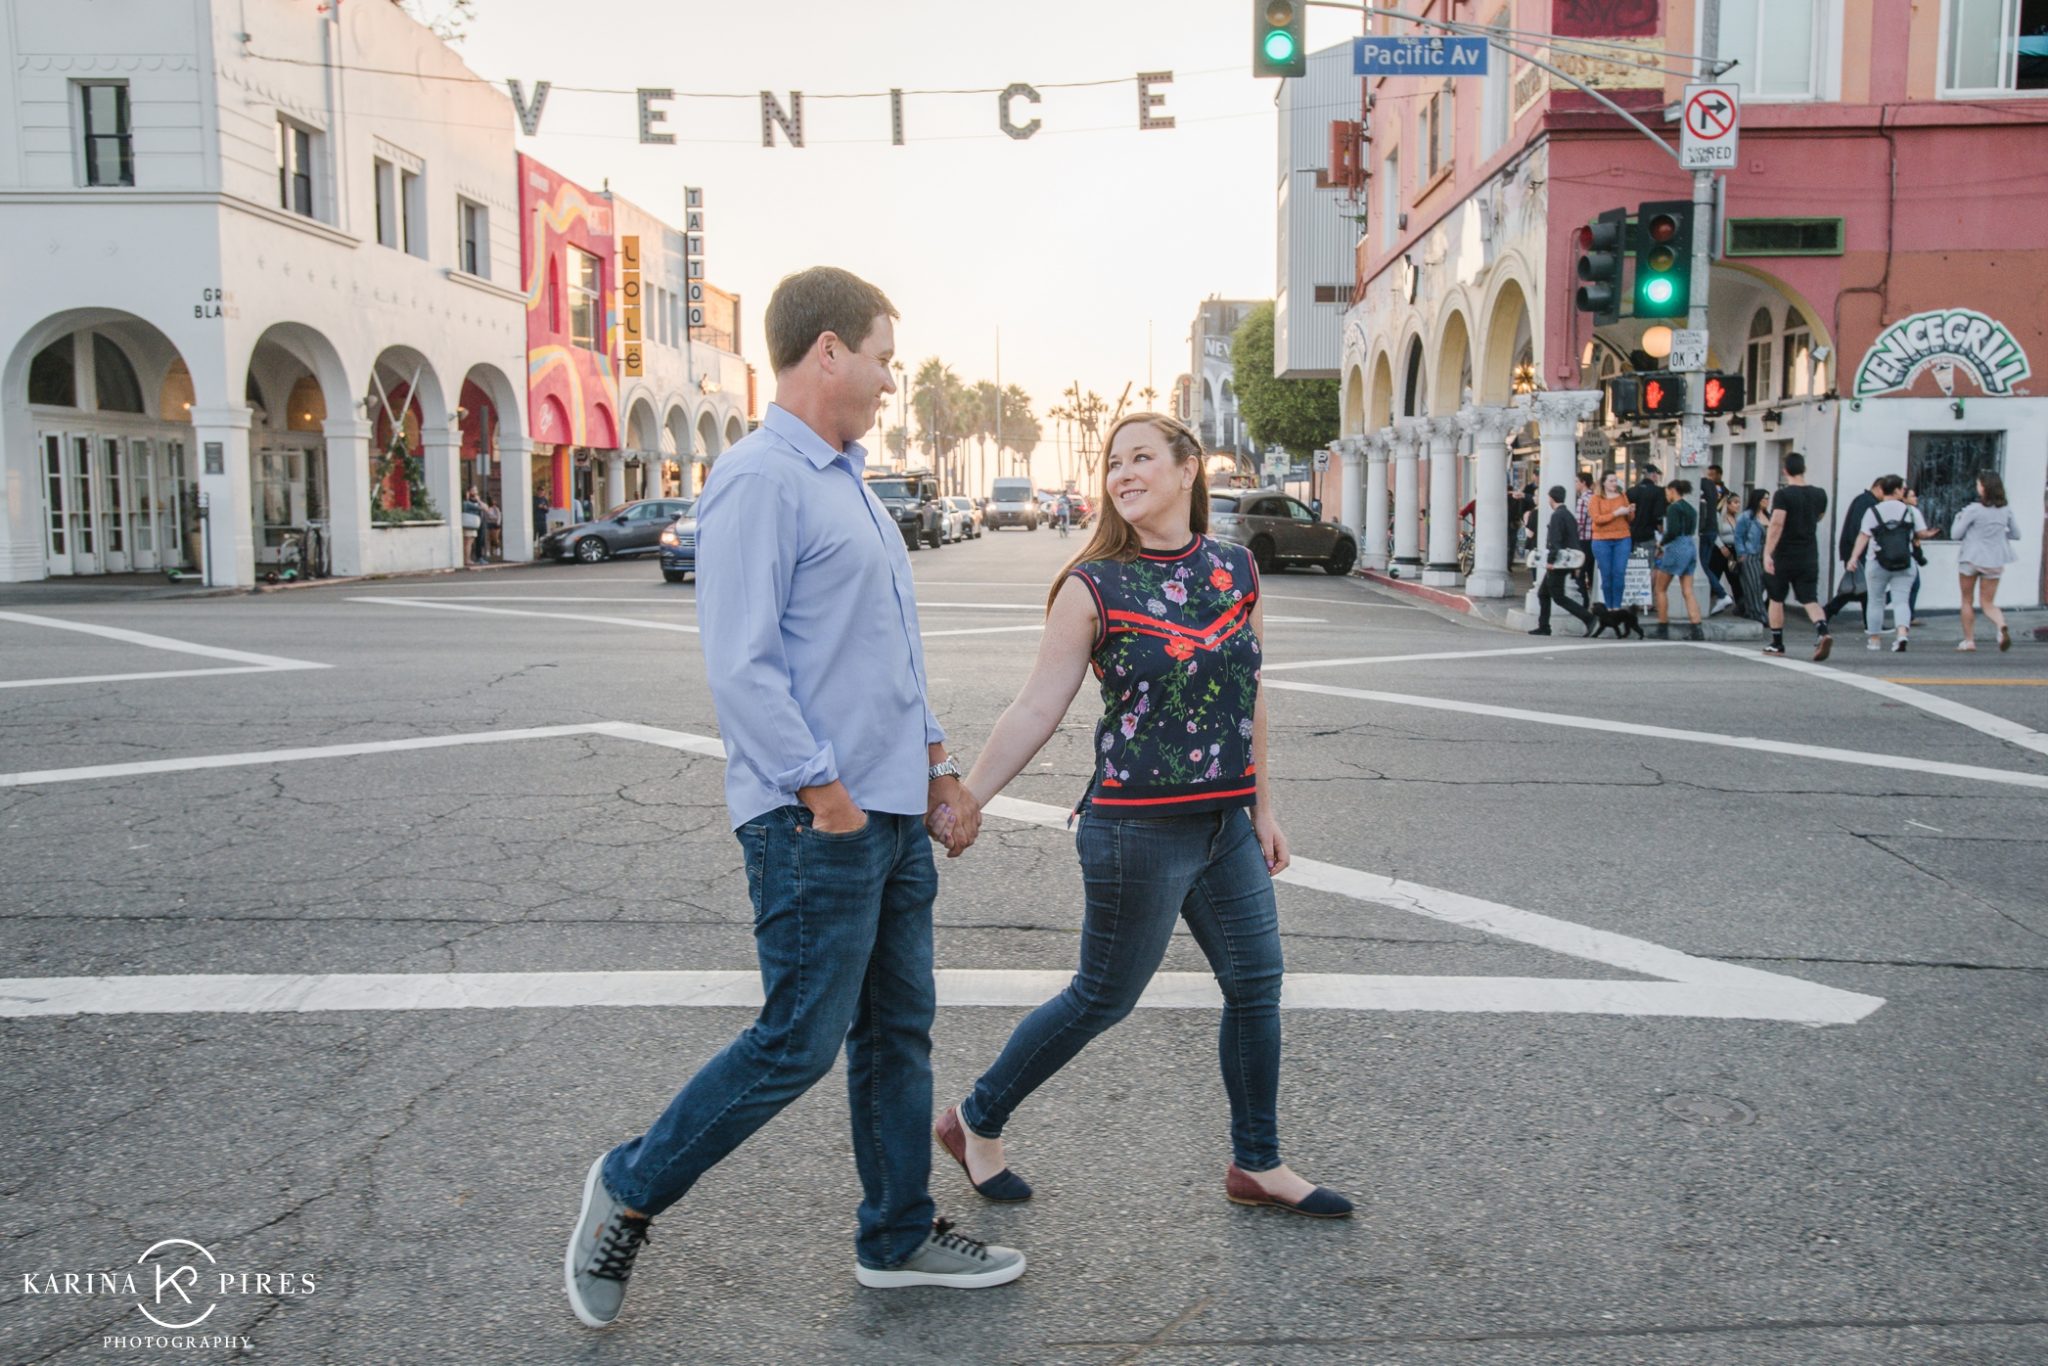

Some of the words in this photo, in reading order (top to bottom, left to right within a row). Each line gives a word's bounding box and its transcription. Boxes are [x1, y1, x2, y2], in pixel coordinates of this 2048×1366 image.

[1363, 44, 1444, 65] Pacific
[1451, 44, 1479, 65] Av
[506, 71, 1175, 147] VENICE
[687, 189, 701, 325] TATTOO
[1672, 351, 1686, 367] OK
